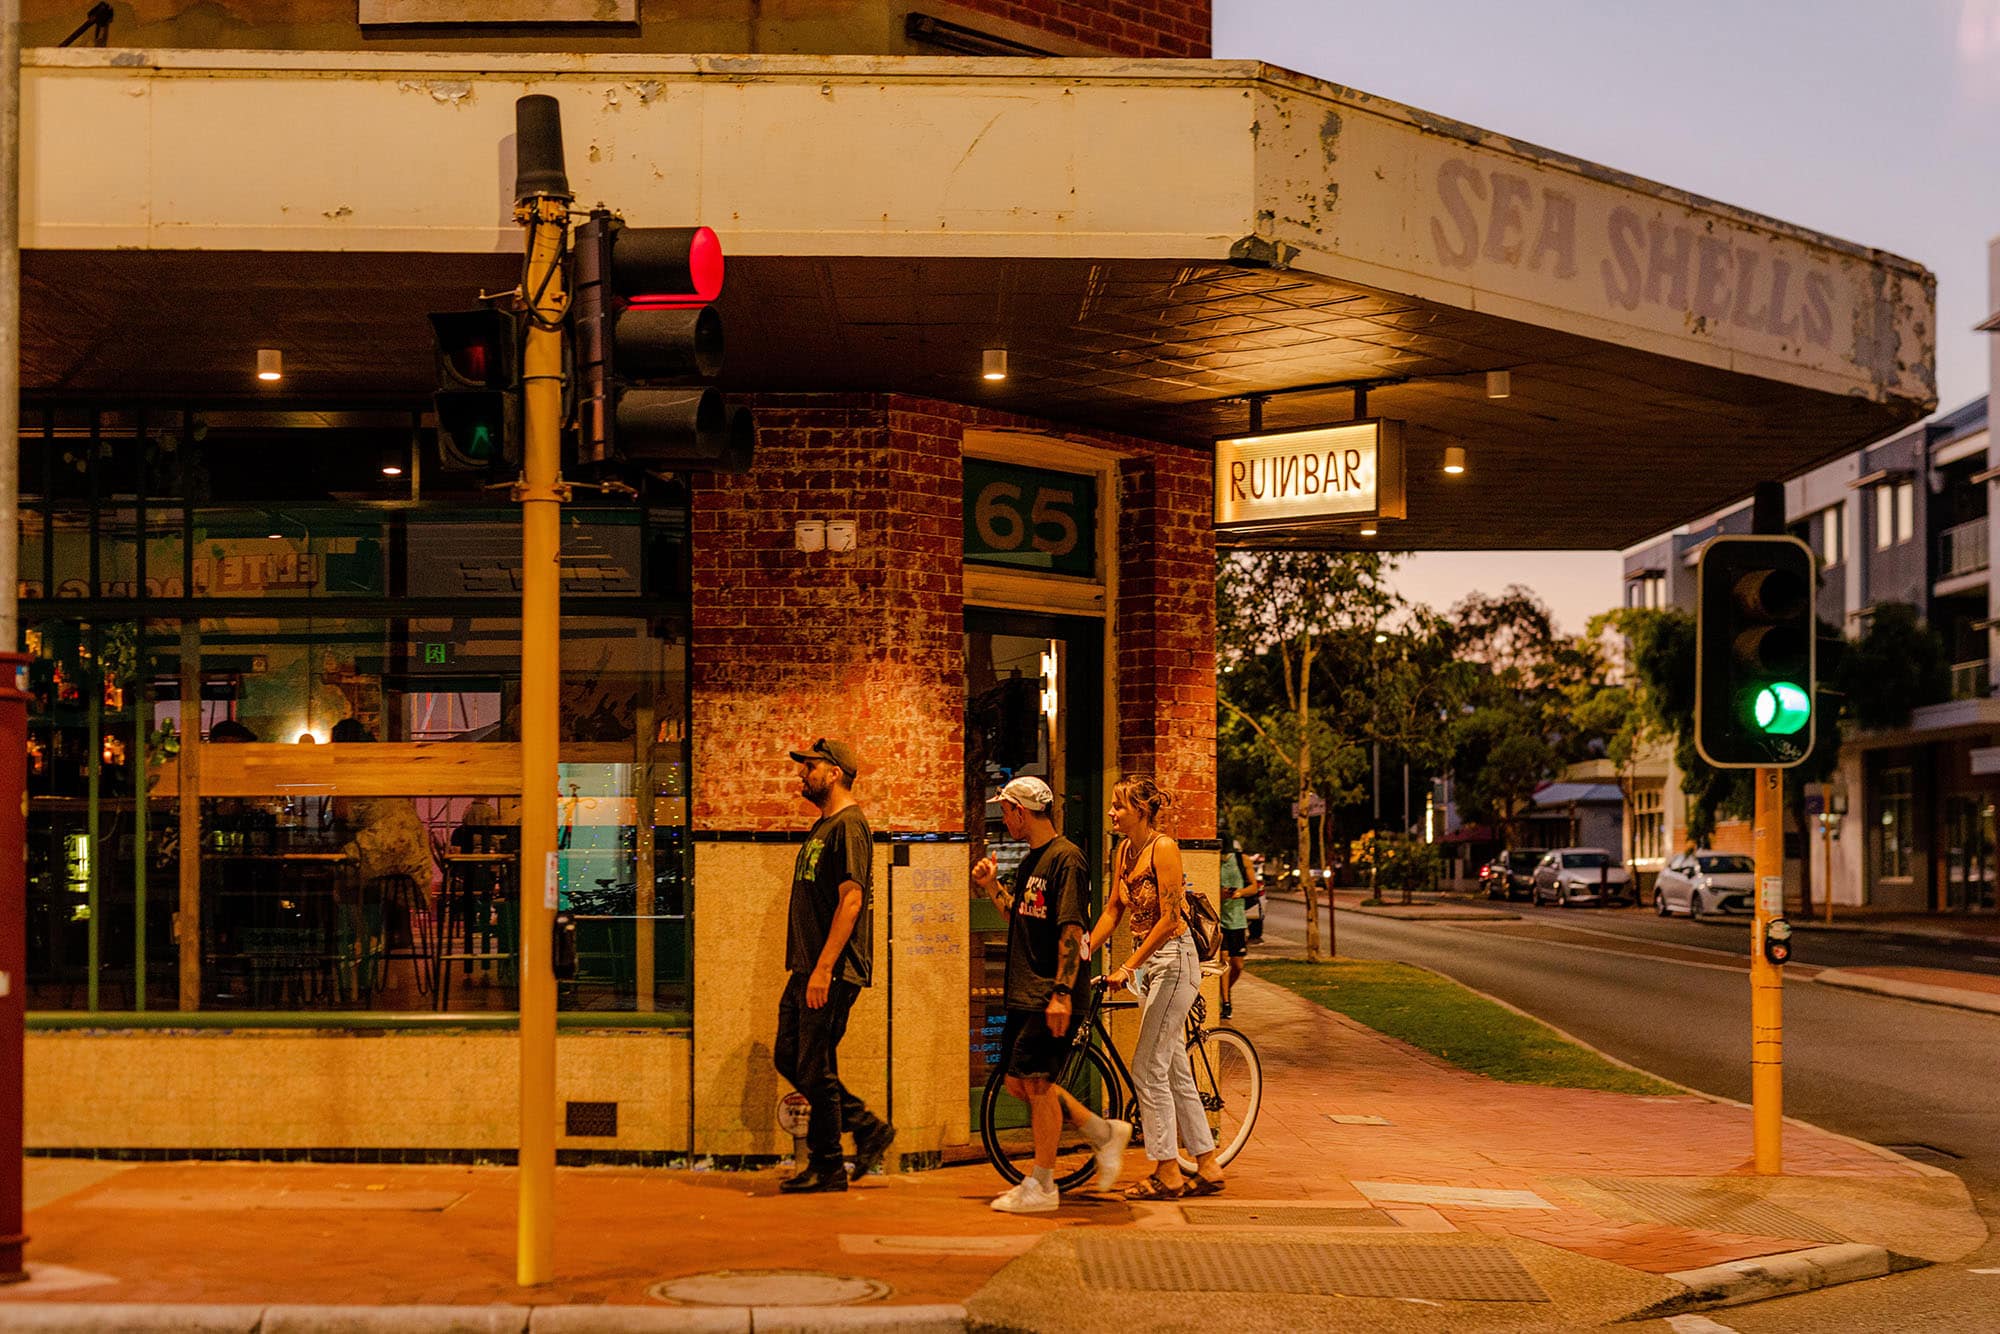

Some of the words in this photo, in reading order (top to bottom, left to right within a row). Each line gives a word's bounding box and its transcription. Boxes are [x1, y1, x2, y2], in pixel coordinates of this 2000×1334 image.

[1430, 158, 1579, 280] SEA
[1600, 205, 1834, 350] SHELLS
[1231, 449, 1361, 502] RUINBAR
[975, 481, 1079, 556] 65
